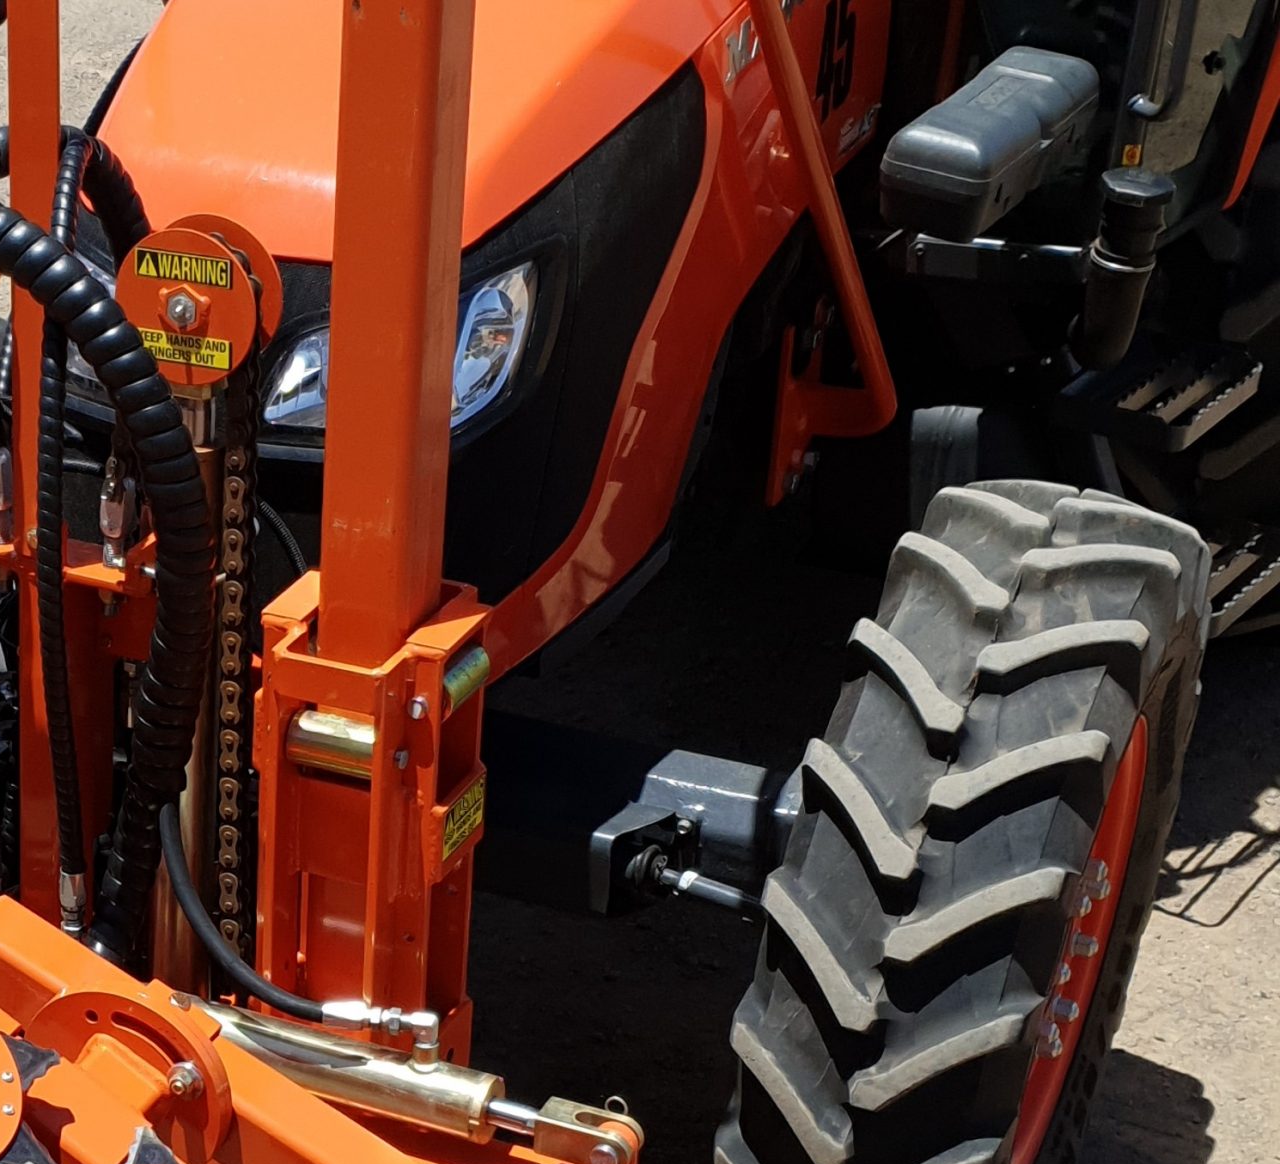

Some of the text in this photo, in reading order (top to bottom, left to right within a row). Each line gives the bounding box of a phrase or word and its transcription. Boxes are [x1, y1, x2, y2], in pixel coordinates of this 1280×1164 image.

[158, 253, 226, 286] WARNING
[167, 334, 201, 349] HANDS
[205, 340, 226, 353] AND
[195, 353, 216, 365] OUT
